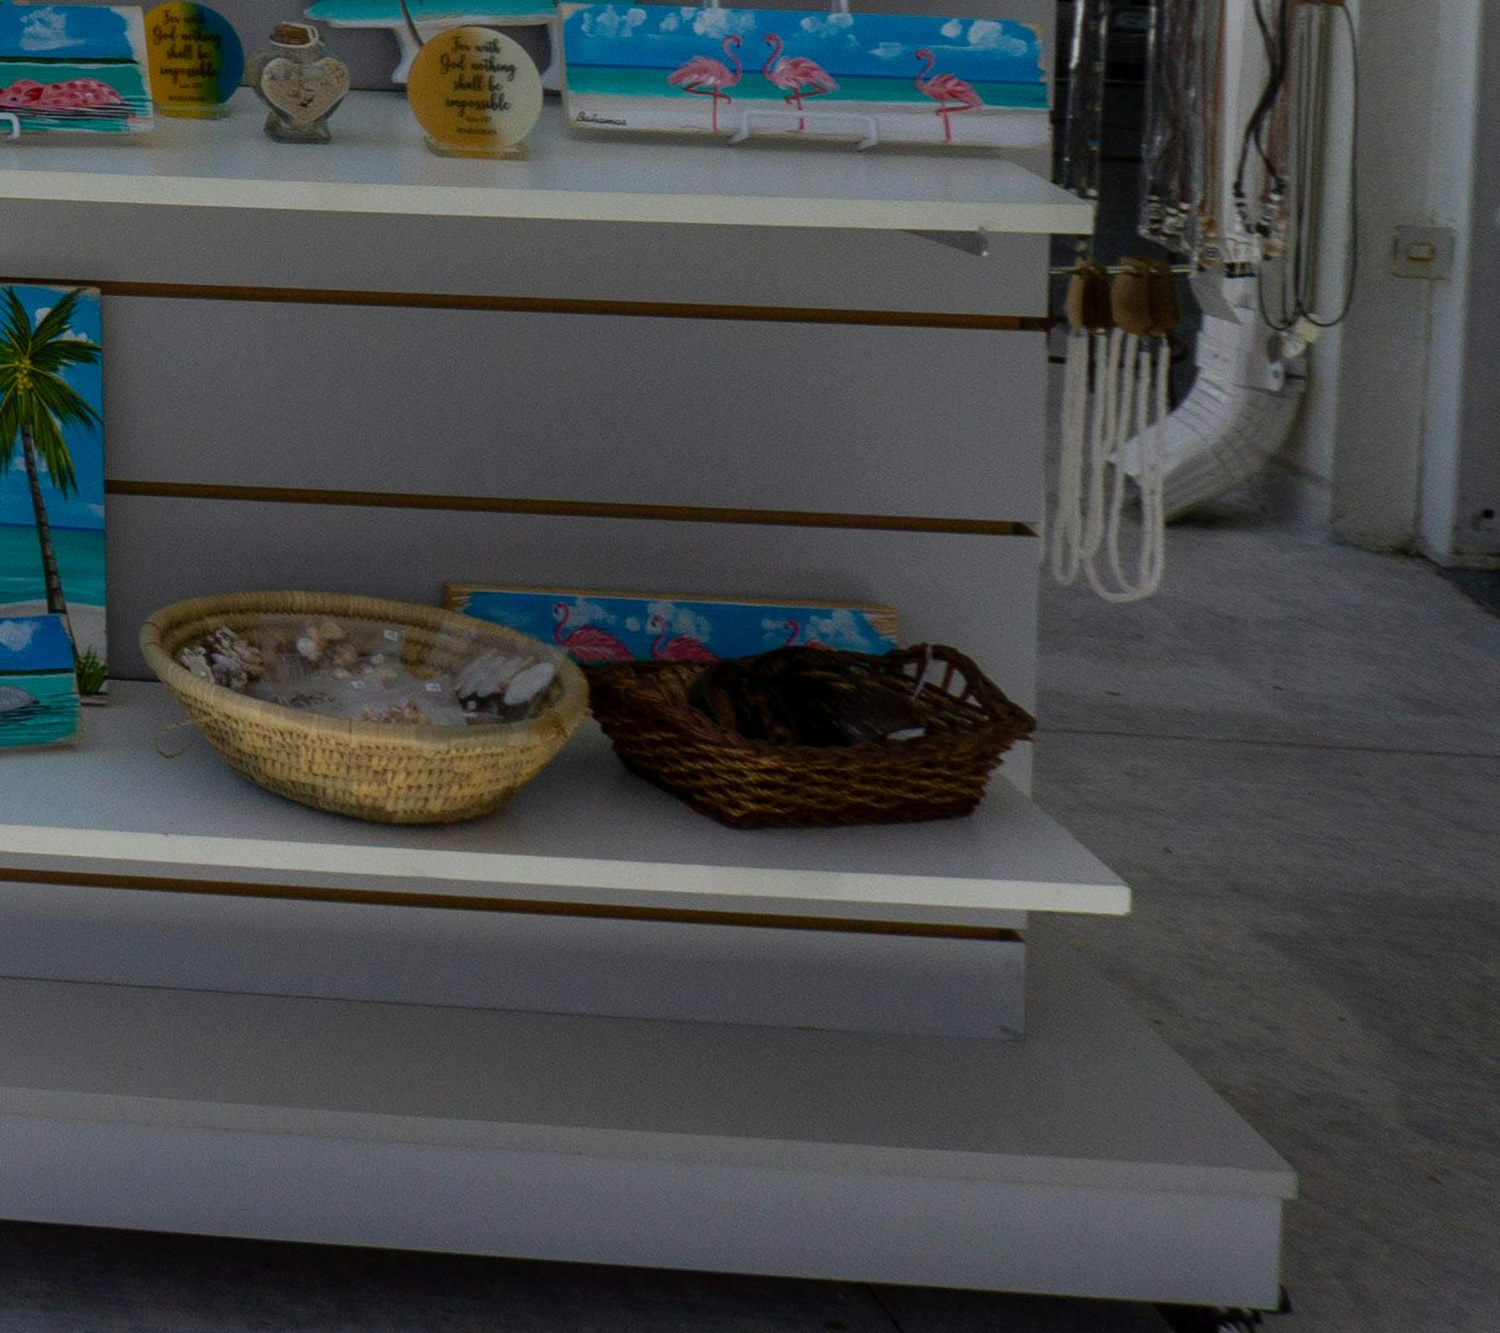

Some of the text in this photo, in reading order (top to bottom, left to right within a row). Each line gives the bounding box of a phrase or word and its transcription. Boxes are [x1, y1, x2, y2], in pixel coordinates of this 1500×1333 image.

[475, 38, 501, 54] with
[160, 60, 217, 85] impossible
[440, 52, 517, 82] God nothing
[455, 73, 504, 91] shall be
[445, 93, 512, 118] impossible
[576, 111, 627, 126] Bahamas
